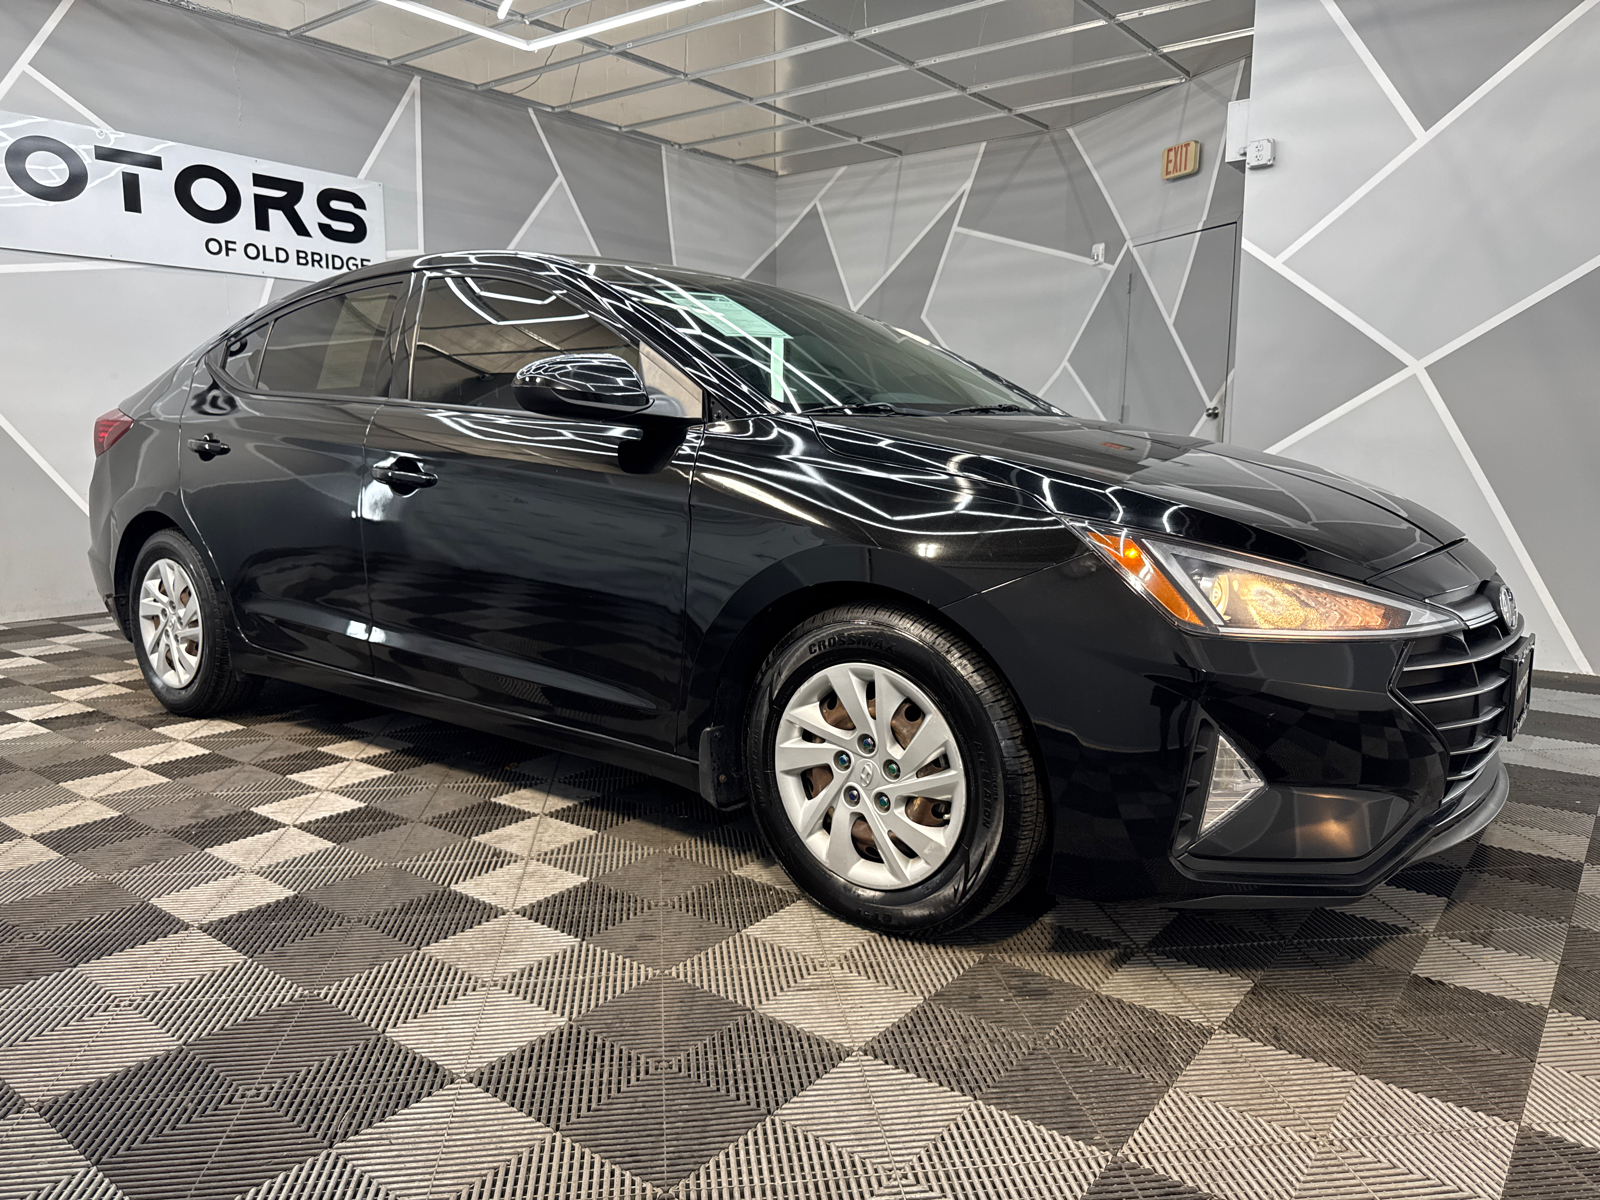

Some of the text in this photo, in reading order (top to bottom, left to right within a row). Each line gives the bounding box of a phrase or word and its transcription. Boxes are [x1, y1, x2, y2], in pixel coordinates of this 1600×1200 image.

[1165, 142, 1191, 177] EXIT
[4, 134, 367, 244] OTORS
[204, 237, 237, 257] OF
[243, 242, 290, 264] OLD
[808, 633, 897, 655] CROSSMAX
